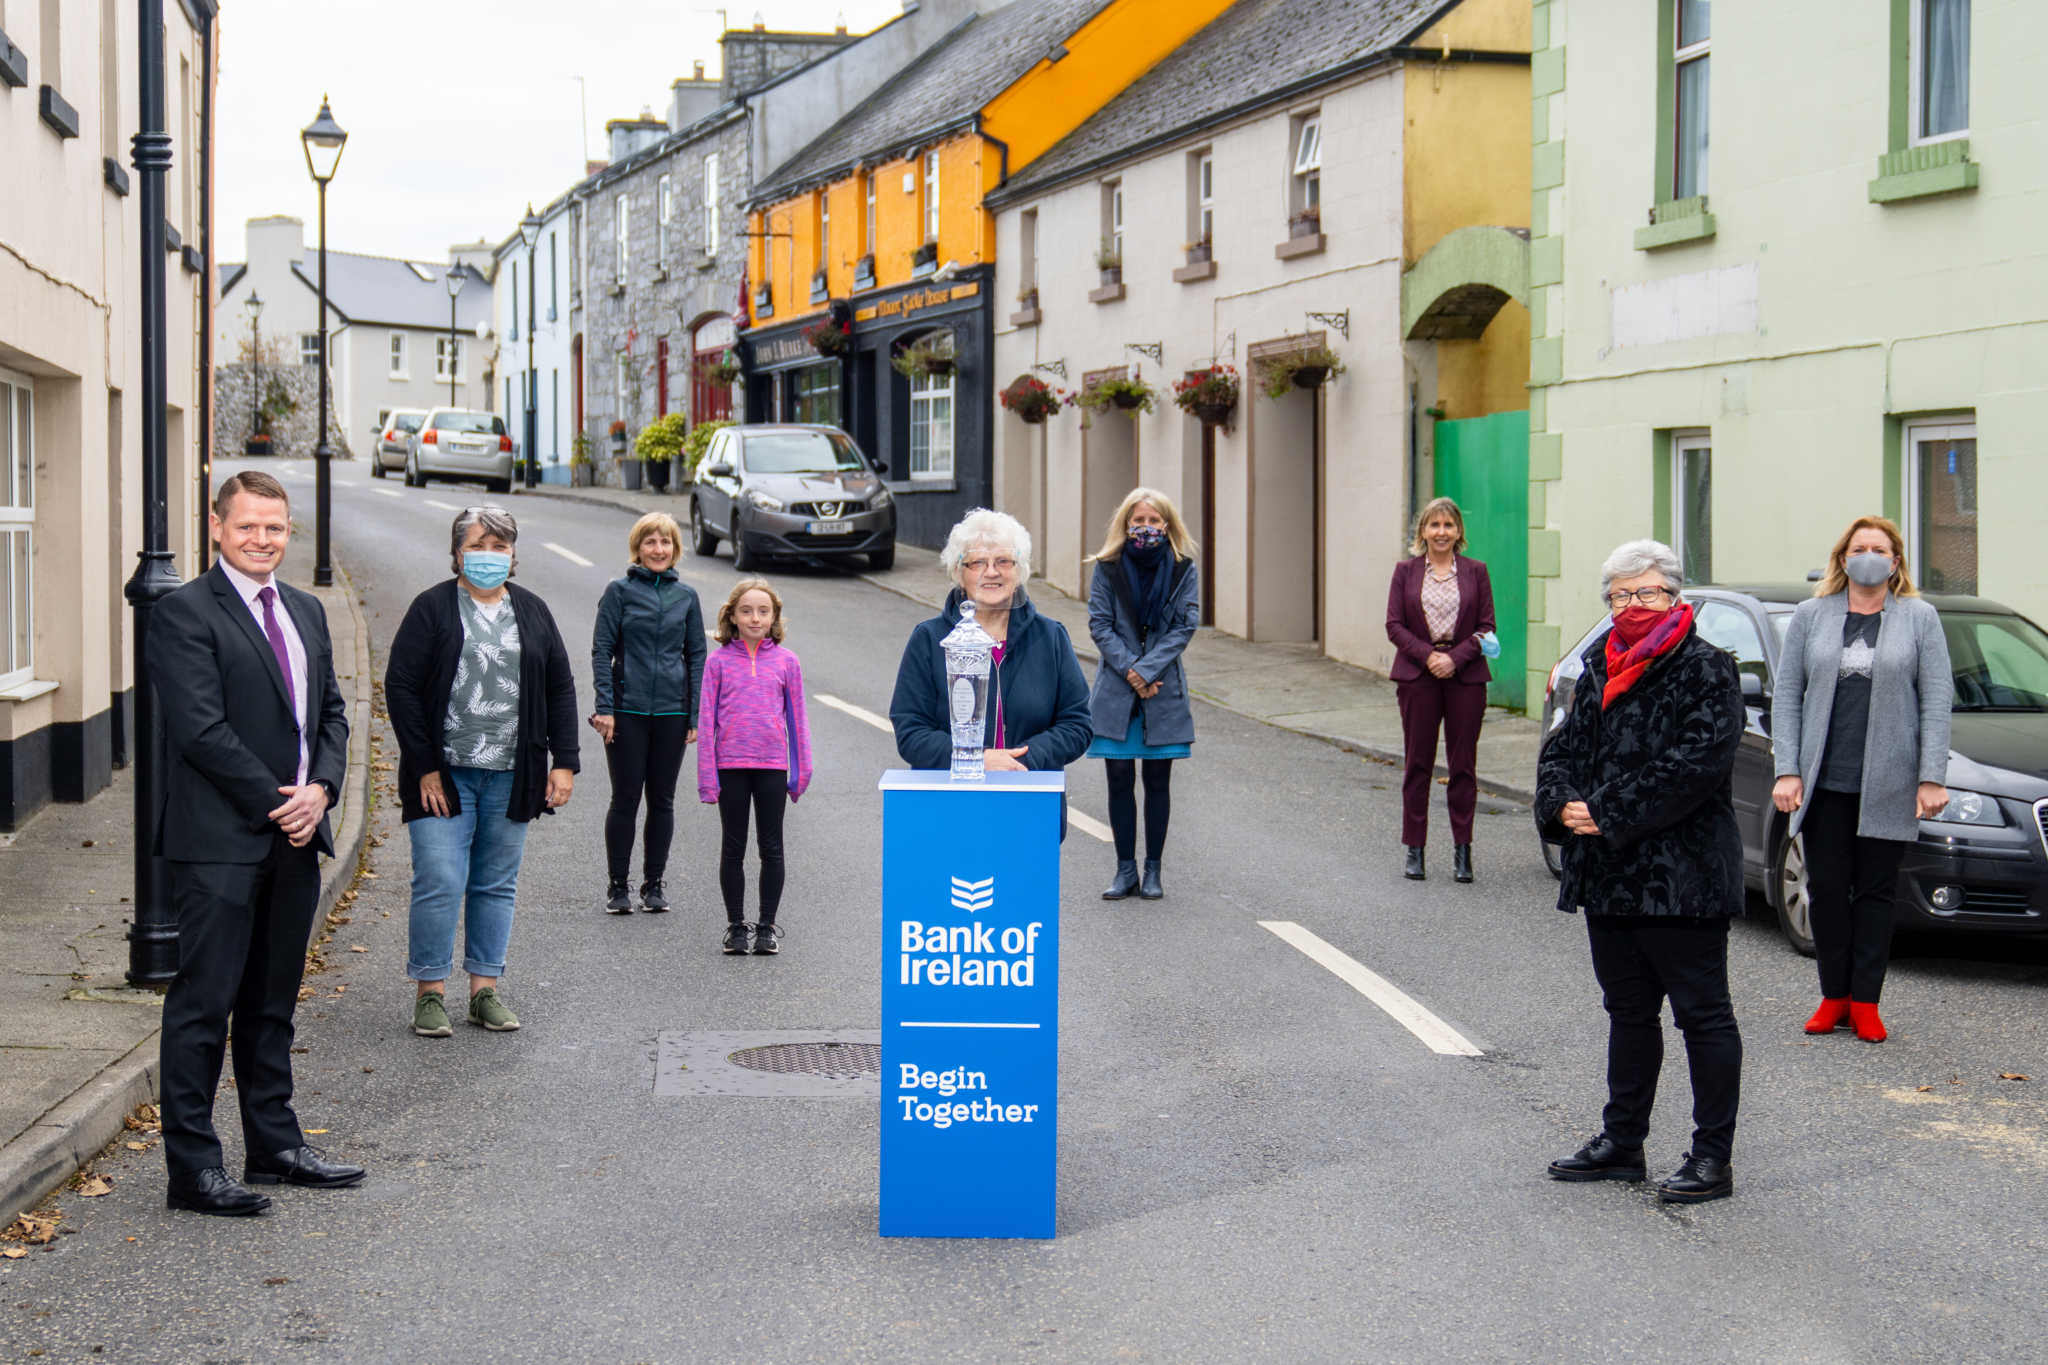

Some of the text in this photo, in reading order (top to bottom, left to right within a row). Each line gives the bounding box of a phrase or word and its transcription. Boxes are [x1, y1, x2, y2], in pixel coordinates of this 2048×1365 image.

[900, 920, 1042, 954] Bank of
[900, 953, 1034, 987] Ireland
[899, 1063, 987, 1097] Begin
[898, 1096, 1039, 1129] Together
